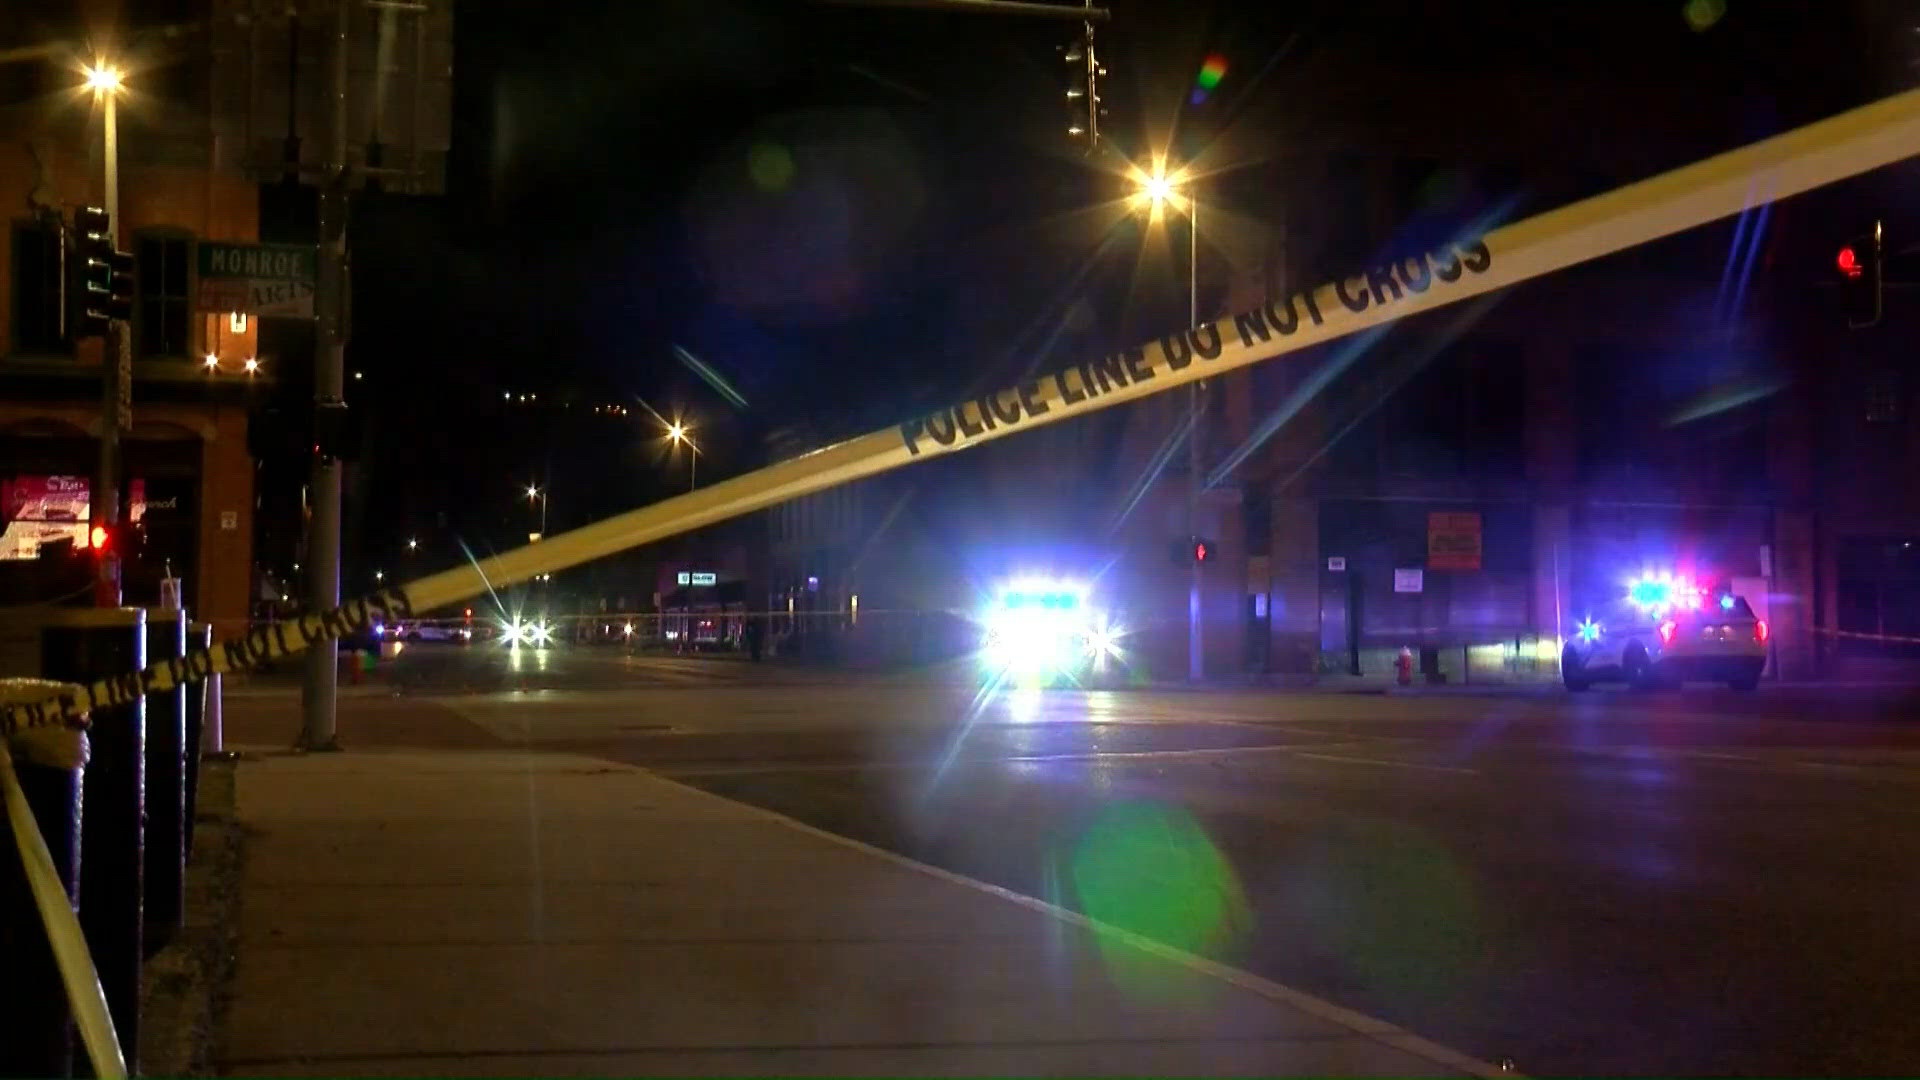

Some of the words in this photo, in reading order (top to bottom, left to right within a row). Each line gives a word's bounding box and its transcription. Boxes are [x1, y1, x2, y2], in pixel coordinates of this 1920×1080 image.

[211, 248, 302, 277] MONROE
[900, 382, 1049, 454] POLICE
[1056, 346, 1155, 405] LINE
[1161, 322, 1222, 369] DO
[1233, 291, 1325, 348] NOT
[1335, 239, 1491, 312] CROSS
[170, 649, 214, 684] DO
[223, 624, 290, 671] NOT
[299, 588, 411, 647] CROSS
